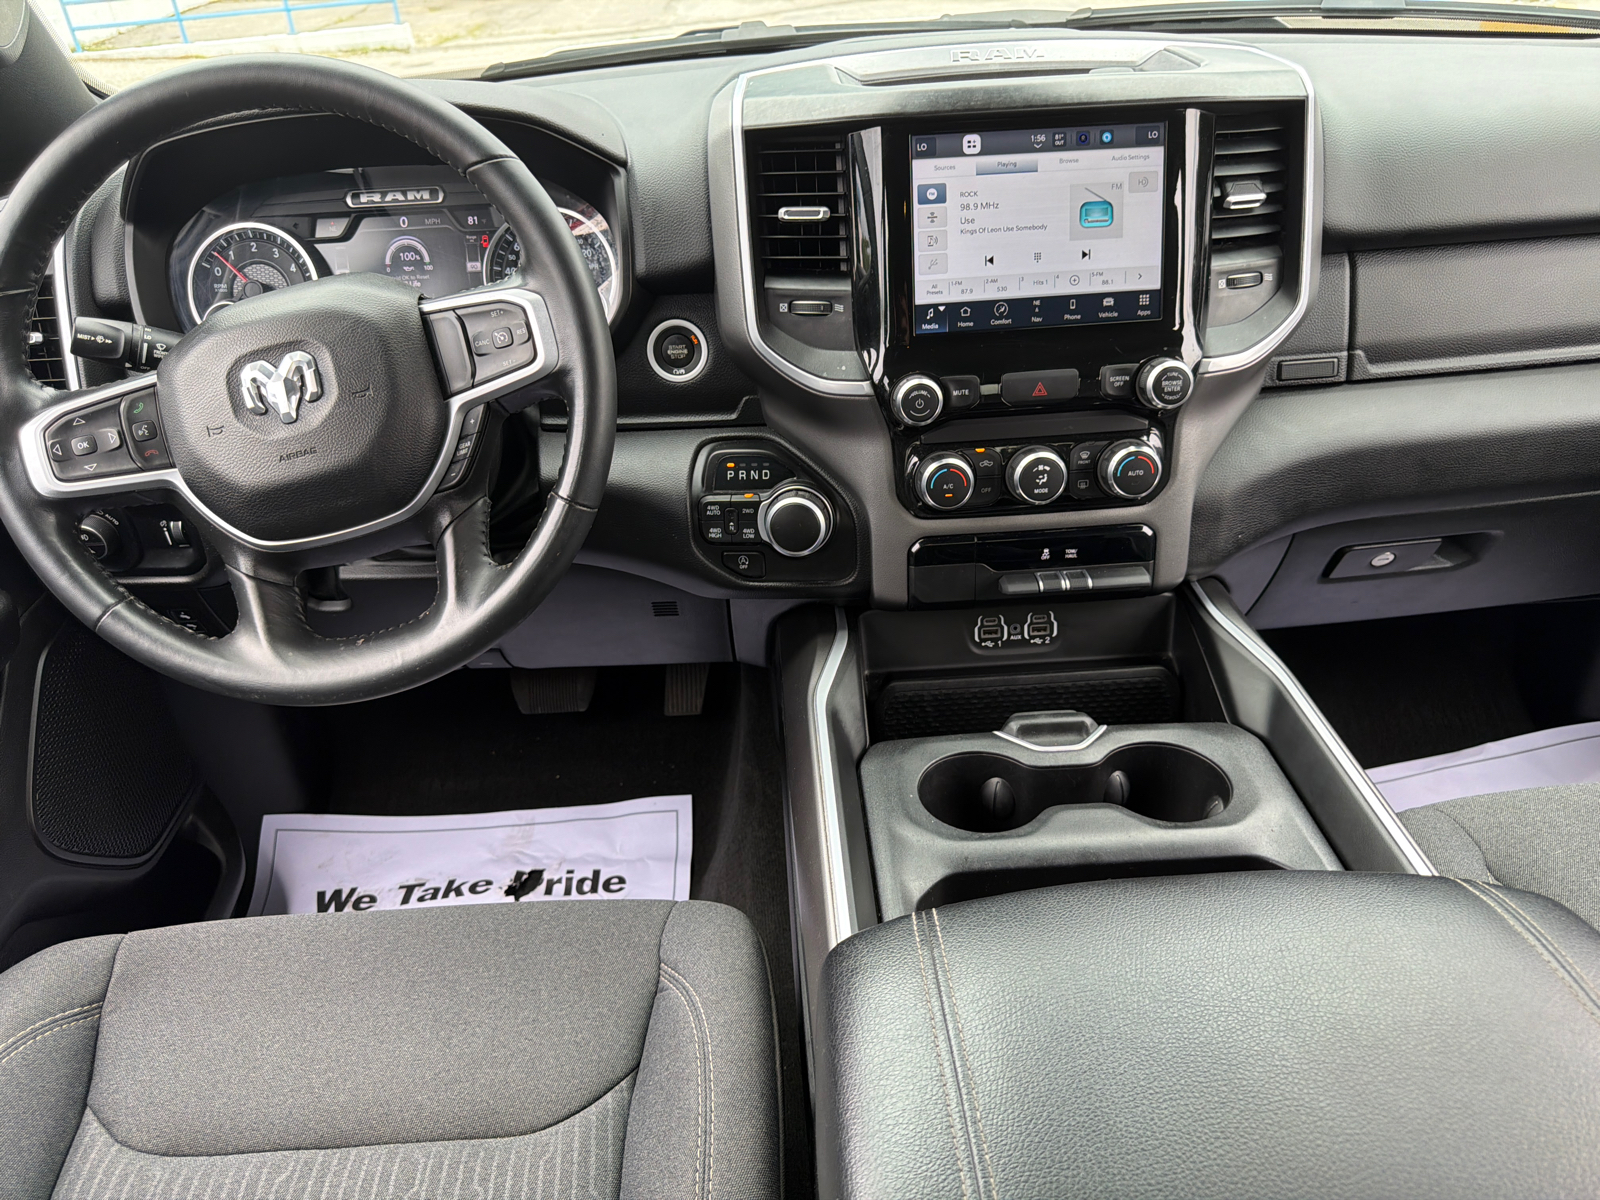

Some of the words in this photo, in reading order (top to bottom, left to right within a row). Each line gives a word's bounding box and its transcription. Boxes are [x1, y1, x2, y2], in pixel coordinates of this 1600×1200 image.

[951, 46, 1045, 62] RAM
[1031, 134, 1046, 142] 1:56
[1147, 131, 1158, 139] LO
[917, 143, 928, 151] LO
[1128, 154, 1150, 162] Settings
[359, 190, 431, 203] RAM
[960, 203, 978, 211] 98.9
[980, 202, 1000, 210] MHz
[400, 217, 408, 228] 0
[467, 216, 478, 225] 81
[960, 228, 978, 236] Kings
[1015, 224, 1048, 232] Somebody
[250, 242, 257, 252] 2
[229, 250, 235, 260] 1
[272, 248, 279, 258] 3
[214, 267, 222, 276] 0
[290, 263, 297, 272] 4
[77, 333, 91, 341] MIST
[474, 339, 490, 347] CANC
[77, 440, 90, 450] OK
[279, 448, 317, 463] AIRBAG
[727, 470, 735, 480] P
[739, 470, 746, 480] R
[750, 470, 758, 480] N
[762, 469, 770, 479] D
[316, 887, 378, 913] We
[398, 879, 493, 905] Take
